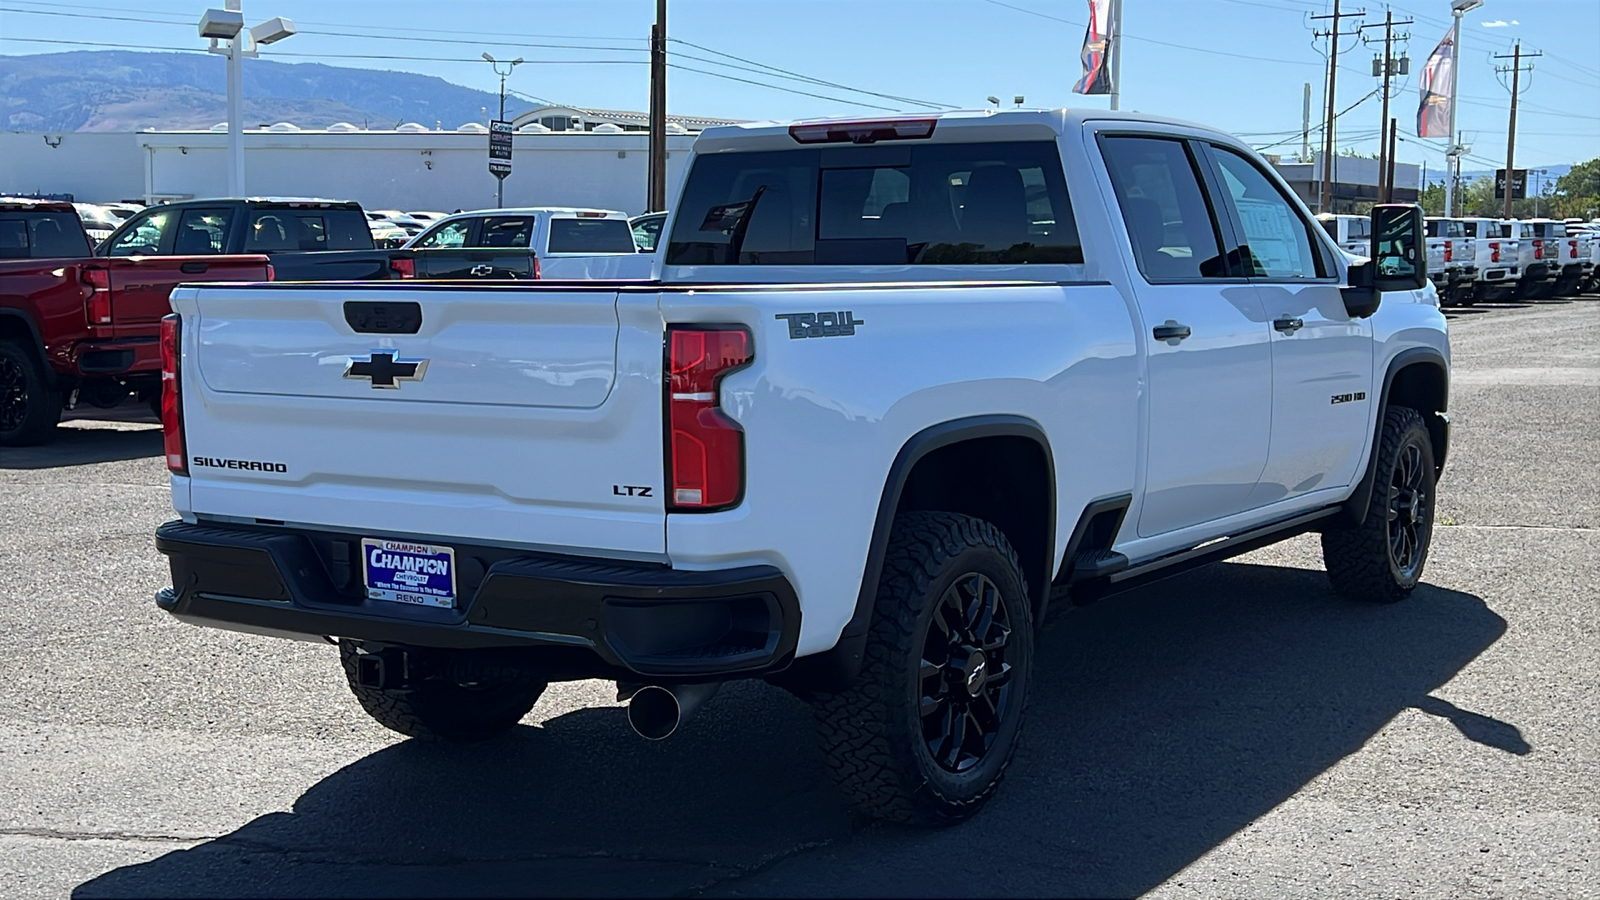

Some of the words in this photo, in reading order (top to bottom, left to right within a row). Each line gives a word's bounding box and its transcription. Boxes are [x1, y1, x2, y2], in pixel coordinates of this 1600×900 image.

[775, 311, 864, 328] TRAIL
[789, 325, 855, 339] BOSS
[1331, 393, 1352, 405] 2500
[1354, 391, 1366, 401] HD
[193, 456, 287, 473] SILVERADO
[613, 484, 653, 497] LTZ
[385, 542, 429, 554] CHAMPION
[370, 548, 448, 576] CHAMPION
[395, 573, 427, 583] CHEVROLET
[396, 593, 424, 604] RENO
